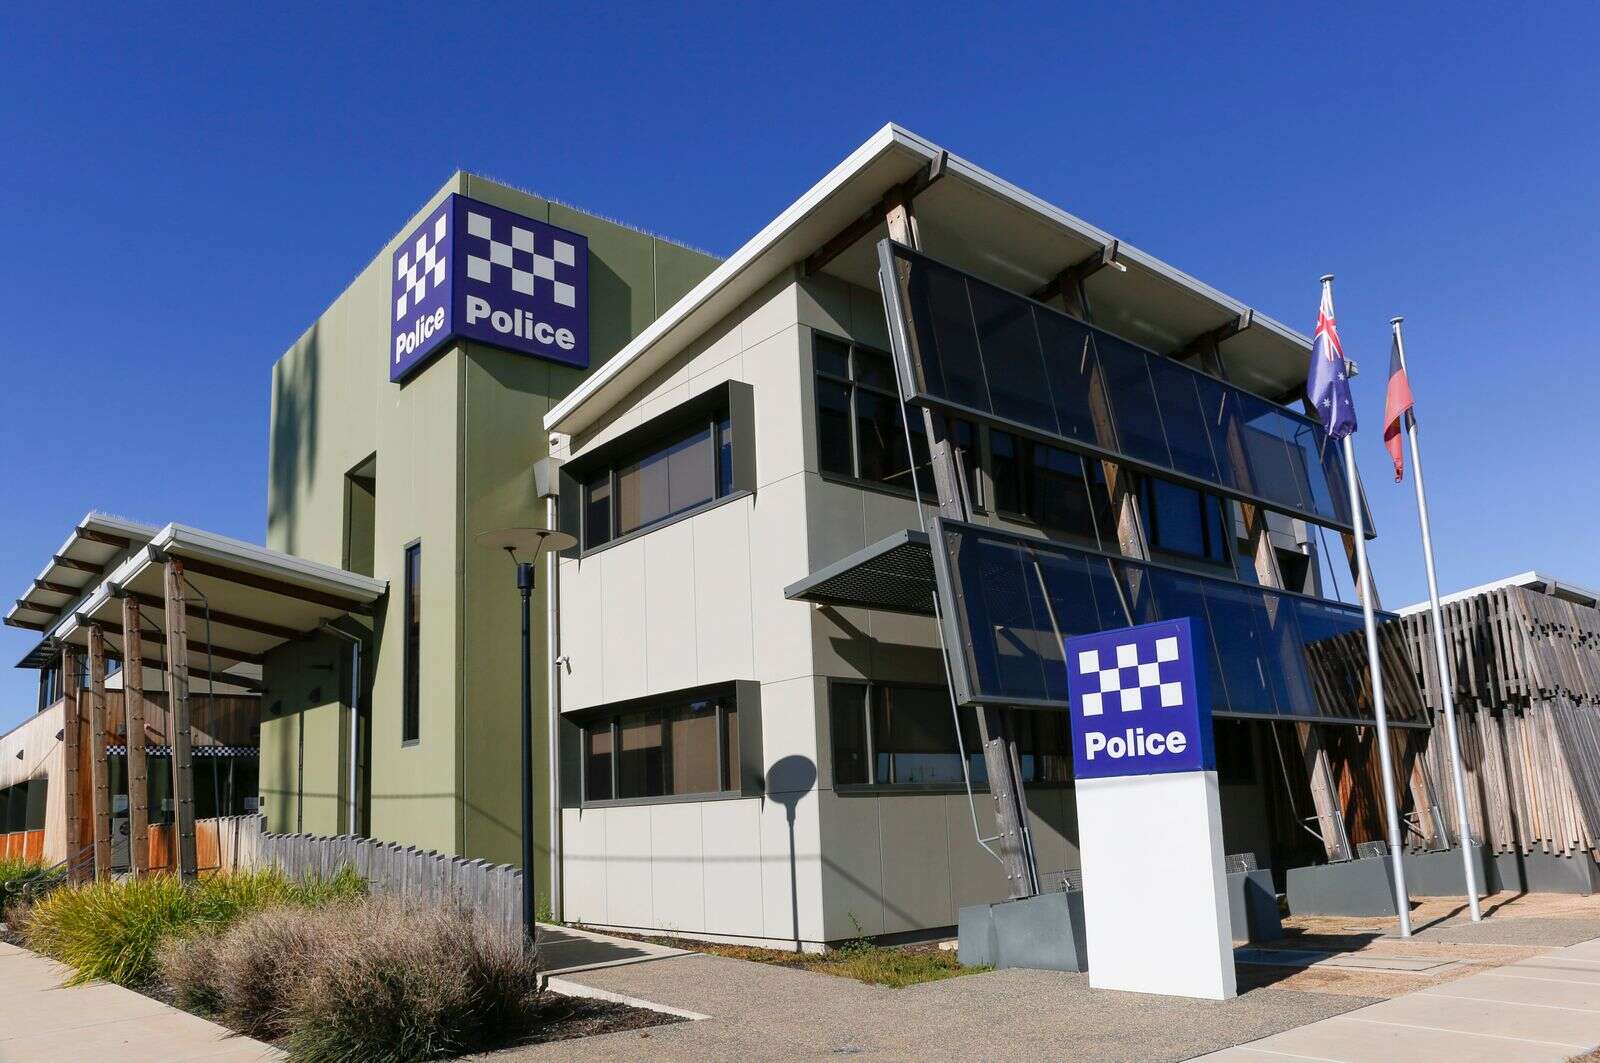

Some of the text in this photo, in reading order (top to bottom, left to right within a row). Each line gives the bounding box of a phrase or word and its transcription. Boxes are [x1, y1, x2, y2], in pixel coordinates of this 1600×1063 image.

[396, 307, 445, 364] Police
[466, 295, 576, 350] Police
[1085, 728, 1187, 760] Police
